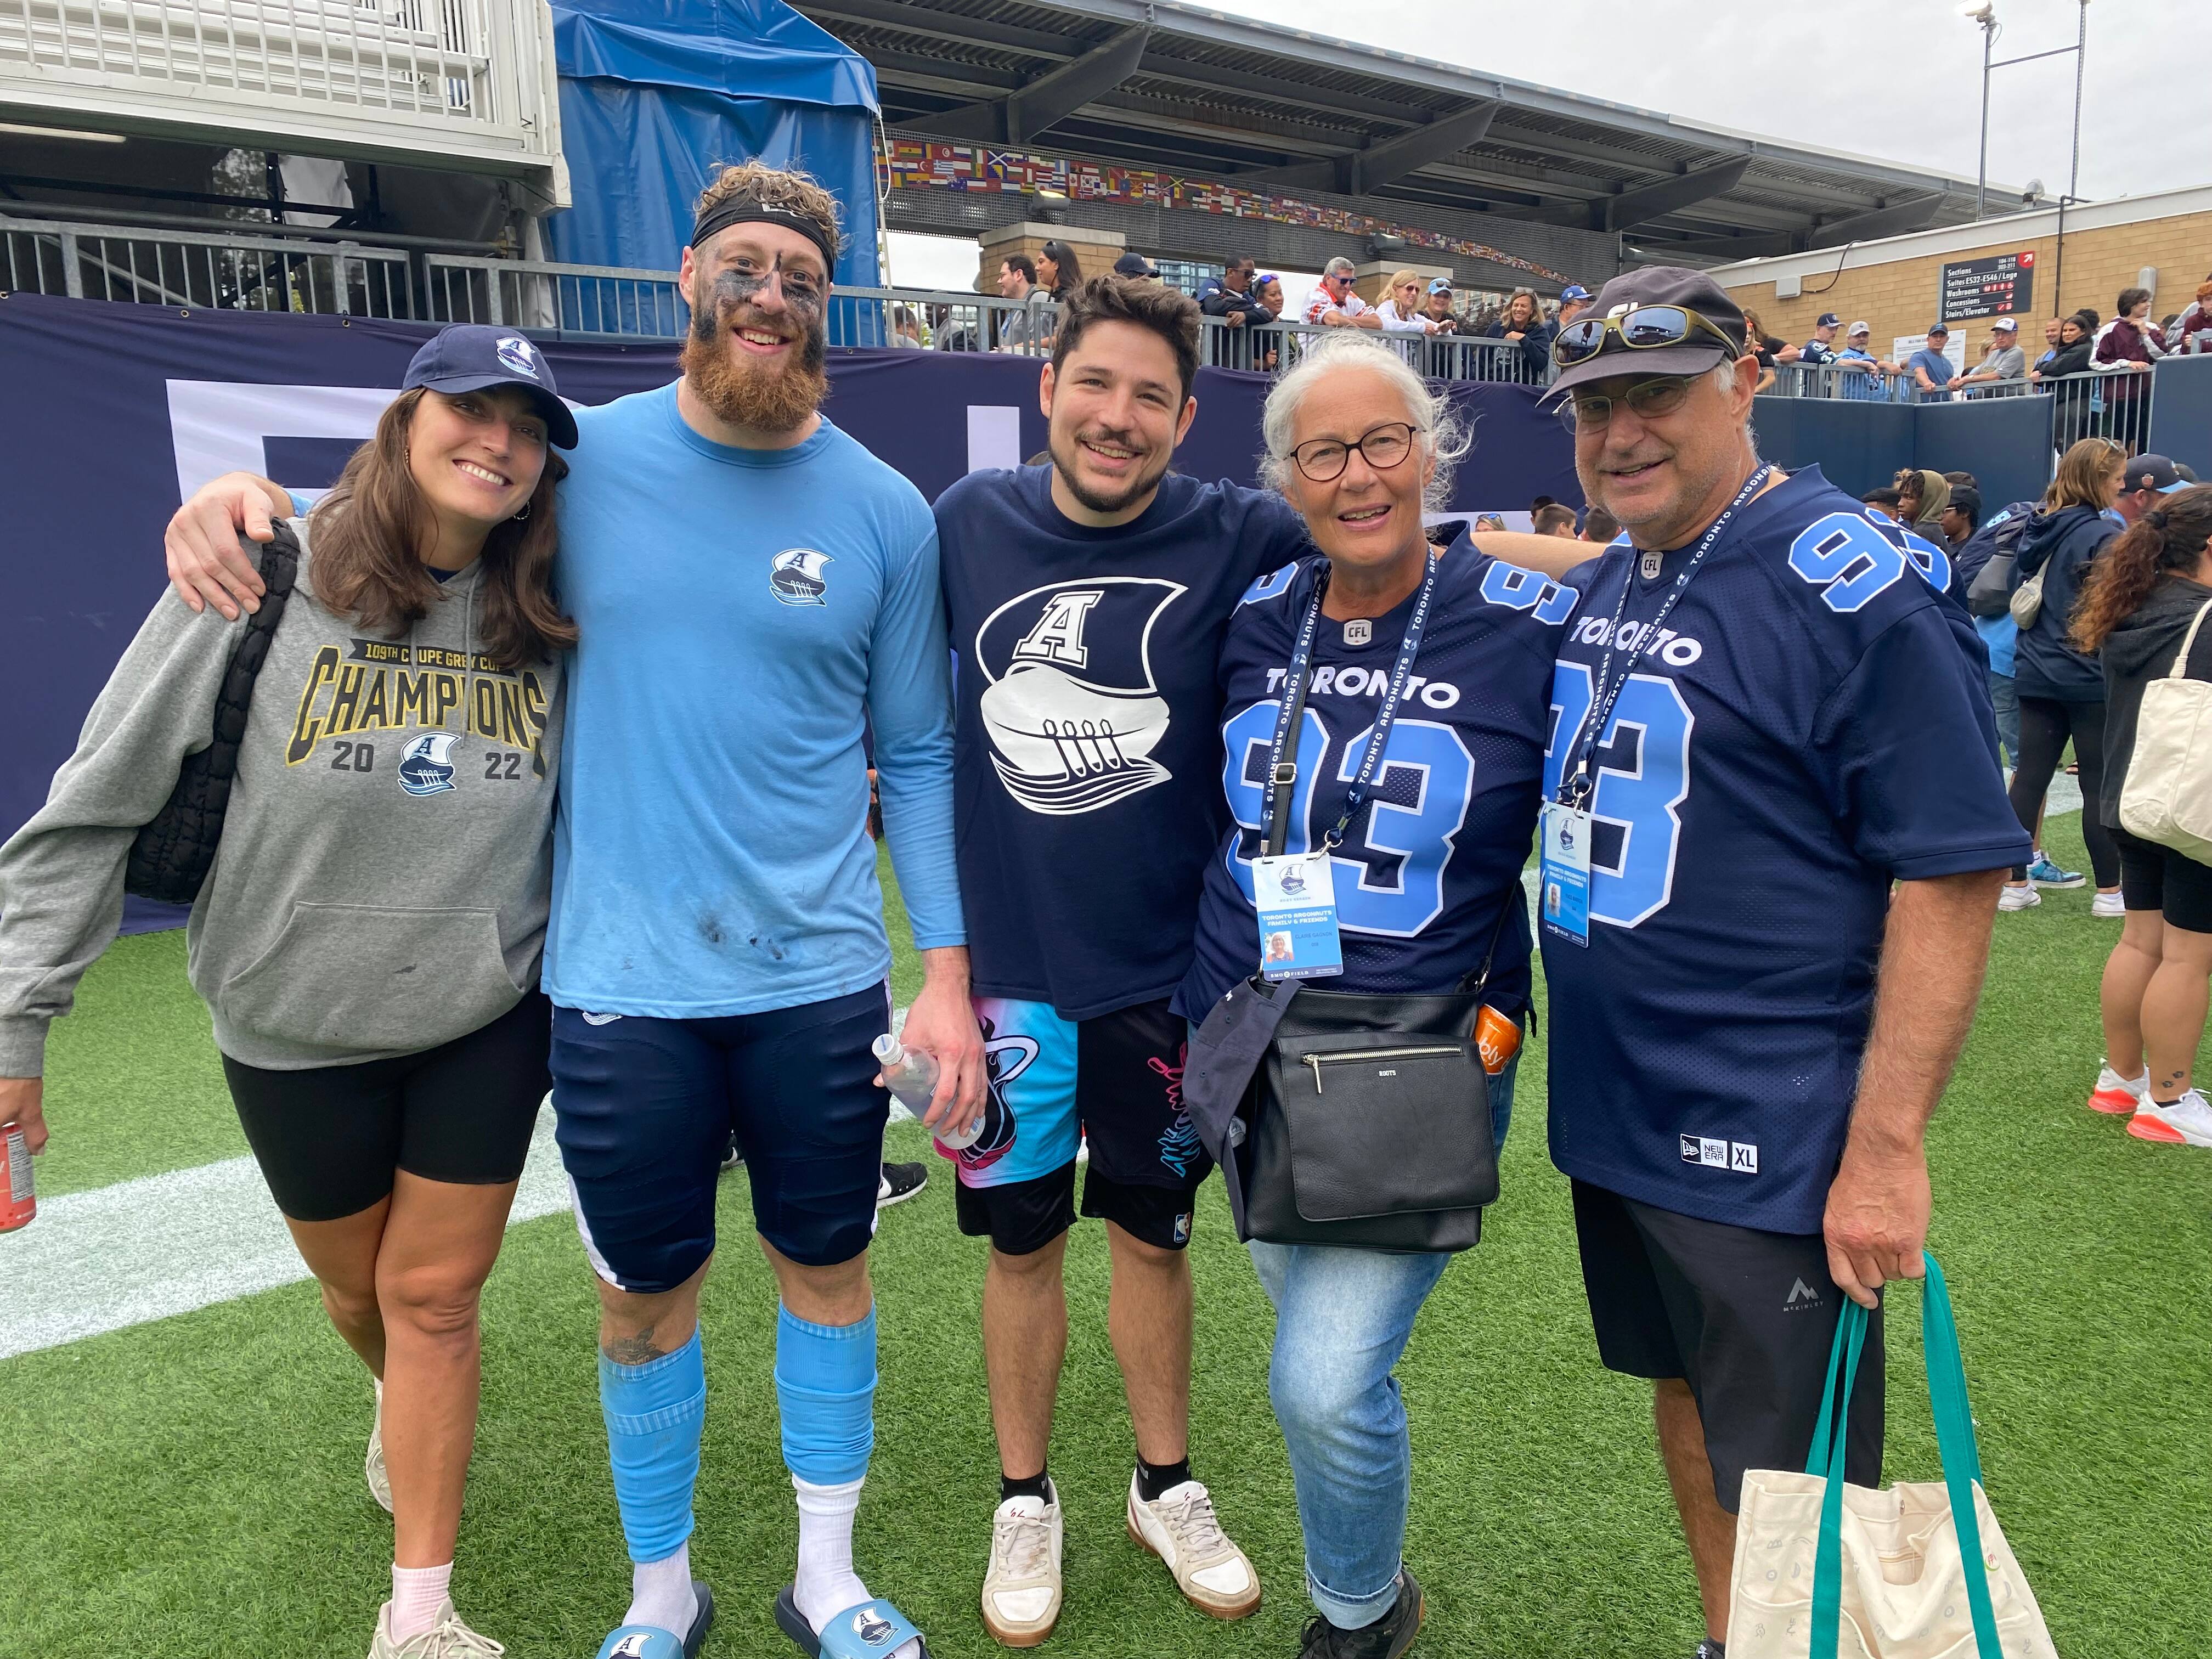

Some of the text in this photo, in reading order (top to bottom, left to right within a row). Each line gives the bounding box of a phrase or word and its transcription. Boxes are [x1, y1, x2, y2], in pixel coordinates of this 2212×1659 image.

[1948, 268, 1972, 276] Sections
[1946, 288, 1979, 297] Washrooms
[1946, 298, 1980, 307] Concessions
[1946, 307, 1990, 318] Stairs/Elevator
[1690, 511, 1731, 566] TORONTO
[1644, 560, 1657, 571] CFL
[1412, 578, 1434, 630] TORONTO
[1012, 590, 1105, 669] A
[1348, 627, 1367, 637] CFL
[365, 643, 398, 659] 109TH
[401, 648, 443, 665] CUPE
[1596, 594, 1675, 731] TORONTO ARGONAUTS
[1280, 673, 1300, 724] TORONTO
[1590, 653, 1610, 725] ARGONAUTS
[1358, 657, 1409, 784] TORONTO ARGONAUTS
[331, 741, 374, 772] 20
[485, 753, 521, 780] 22
[1223, 699, 1475, 937] 93
[1294, 910, 1332, 918] ARGONAUTS
[1705, 1144, 1724, 1153] NEW
[1705, 1152, 1724, 1161] ERA
[1735, 1147, 1754, 1167] XL
